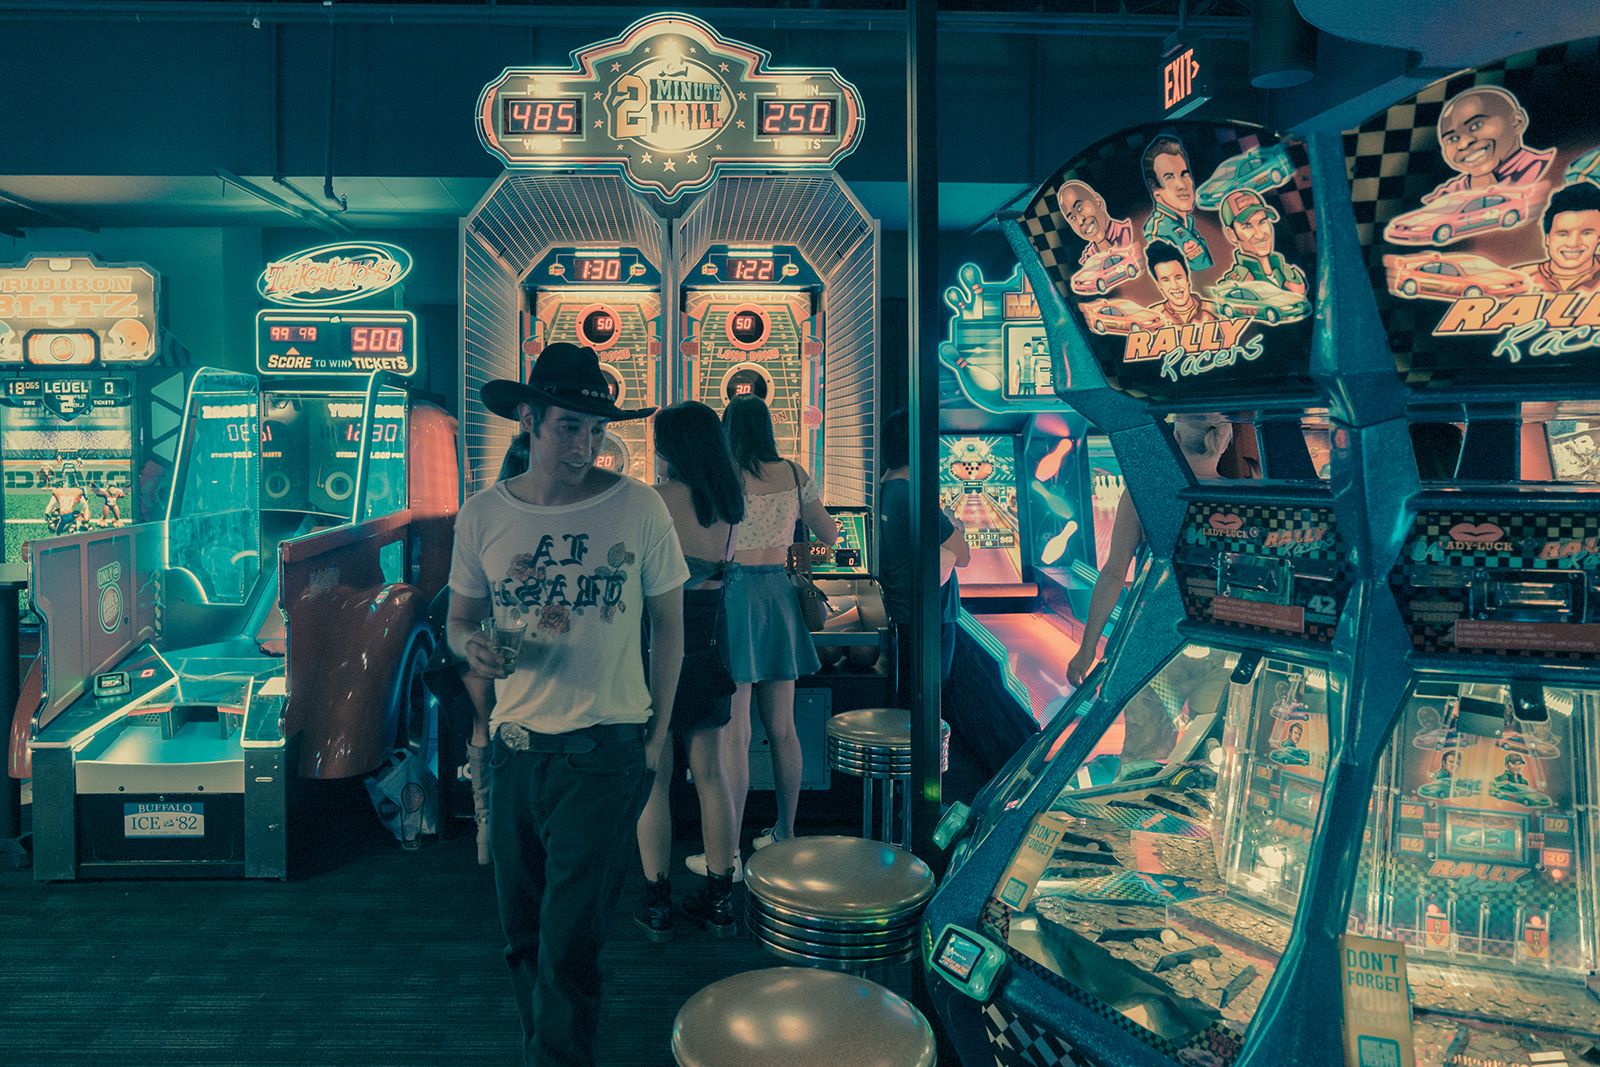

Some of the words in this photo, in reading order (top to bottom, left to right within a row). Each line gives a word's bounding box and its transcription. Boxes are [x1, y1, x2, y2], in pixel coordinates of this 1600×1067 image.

[1164, 48, 1194, 110] EXIT
[612, 73, 647, 138] 2
[655, 79, 722, 102] MINUTE
[513, 103, 575, 131] 485
[656, 103, 723, 131] DRILL
[764, 104, 829, 132] 250
[582, 259, 620, 280] 1:30
[735, 259, 774, 280] 1:22
[0, 275, 133, 293] RIDIRON
[1432, 290, 1600, 336] RALL
[597, 318, 613, 330] 50
[736, 318, 752, 330] 50
[353, 329, 402, 352] 500
[1124, 317, 1253, 363] RALLY
[267, 354, 312, 369] SCORE
[315, 359, 327, 368] TO
[328, 359, 348, 368] WIN
[352, 356, 408, 370] TICKETS
[1160, 333, 1264, 382] Racers
[44, 381, 89, 394] LEVEL
[104, 382, 114, 395] 0
[596, 456, 612, 467] 20
[4, 470, 131, 489] DEMO
[1202, 527, 1249, 539] LADY-LUCK
[1264, 527, 1328, 548] RALLY
[810, 546, 826, 555] 250
[1439, 540, 1514, 552] LADY-LUCK
[1538, 536, 1600, 561] RAL
[848, 557, 855, 566] 0
[1308, 595, 1337, 615] 42
[138, 803, 193, 813] BUFFALO
[131, 816, 161, 830] ICE
[1031, 823, 1060, 844] DON'T
[1025, 837, 1053, 856] FORGET
[1428, 859, 1531, 882] RALLY
[1346, 948, 1399, 974] DON'T
[1346, 970, 1401, 993] FORGET
